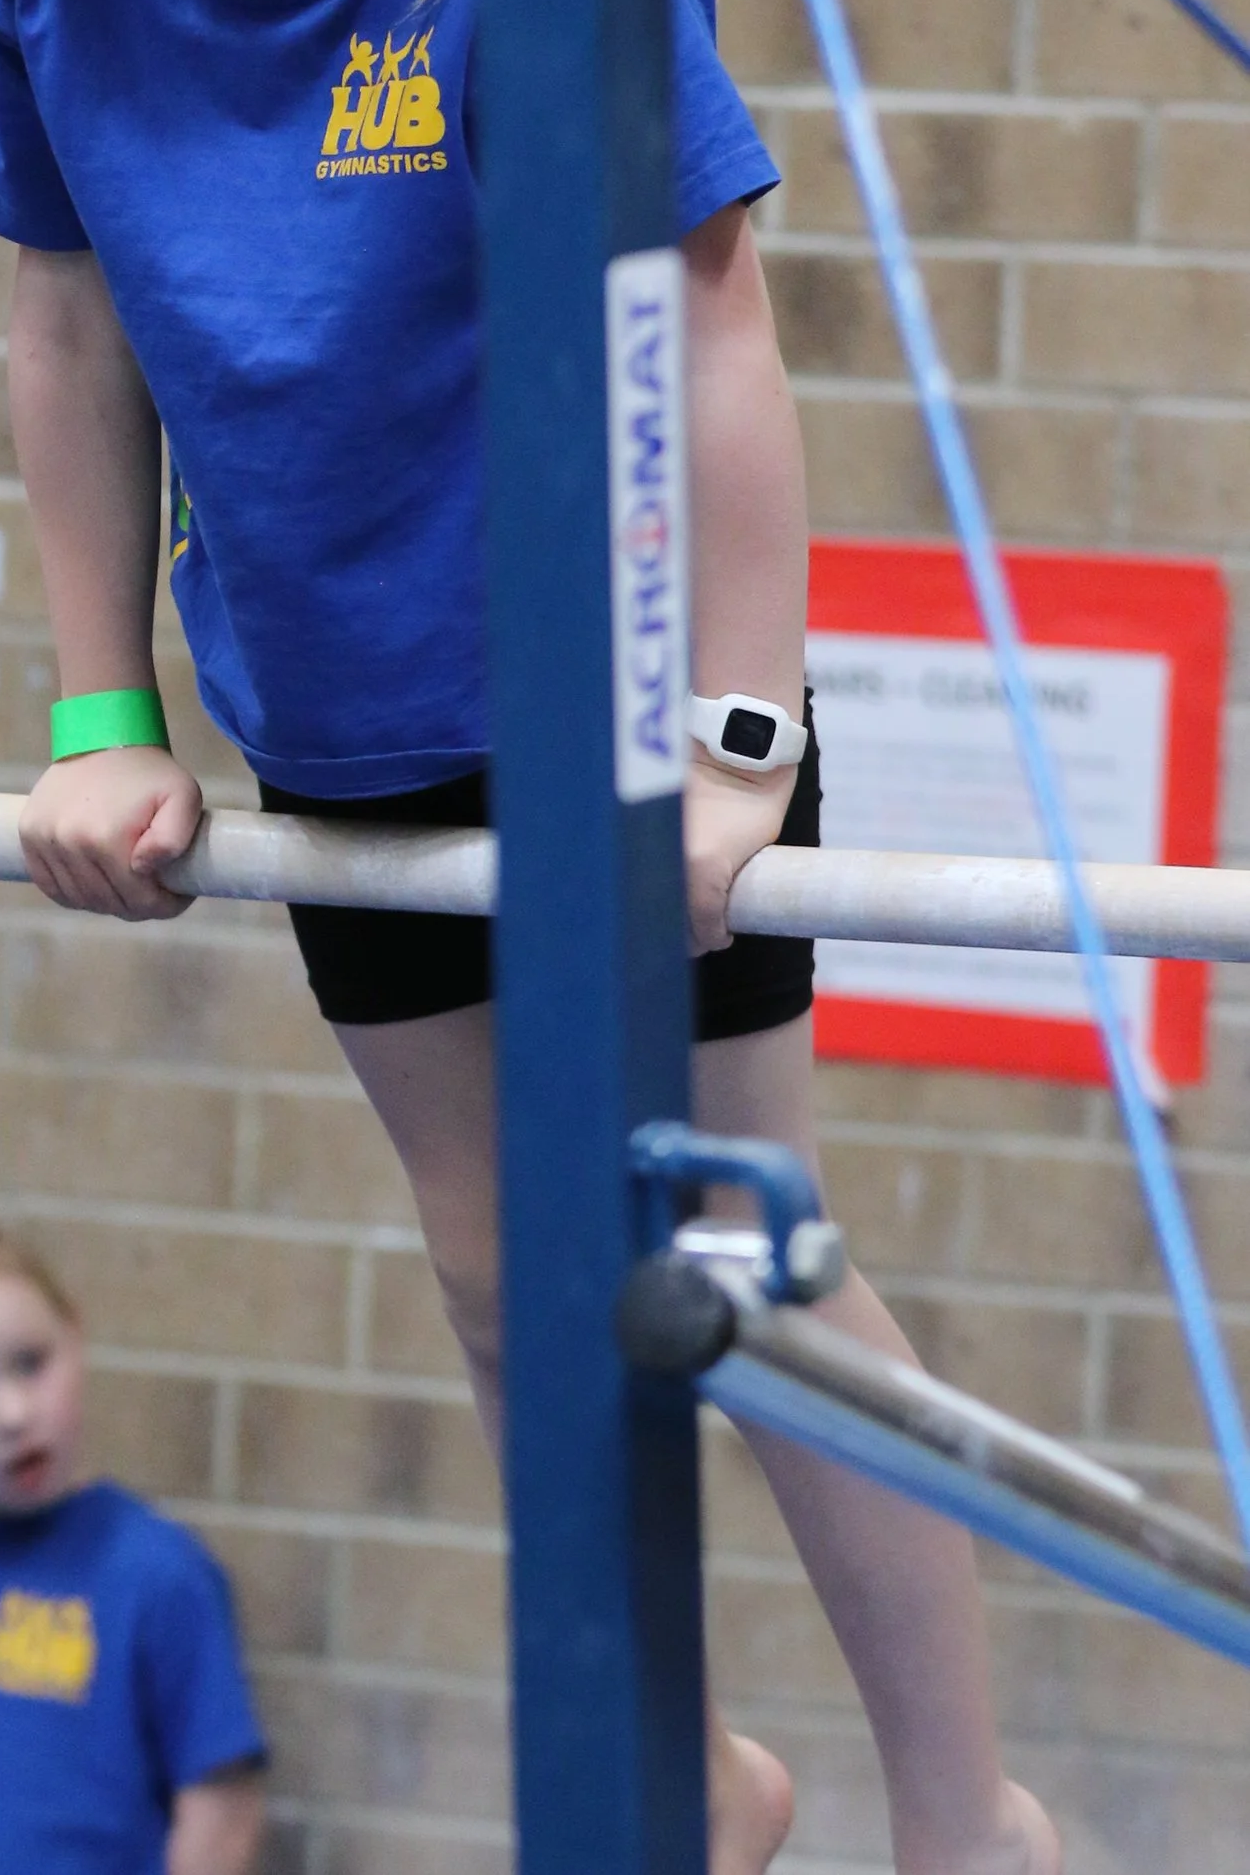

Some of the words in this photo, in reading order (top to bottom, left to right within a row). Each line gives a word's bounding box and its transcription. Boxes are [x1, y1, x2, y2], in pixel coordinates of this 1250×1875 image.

[321, 74, 446, 155] HUB
[316, 151, 448, 180] GYMNASTICS
[625, 301, 670, 759] ACROMAT
